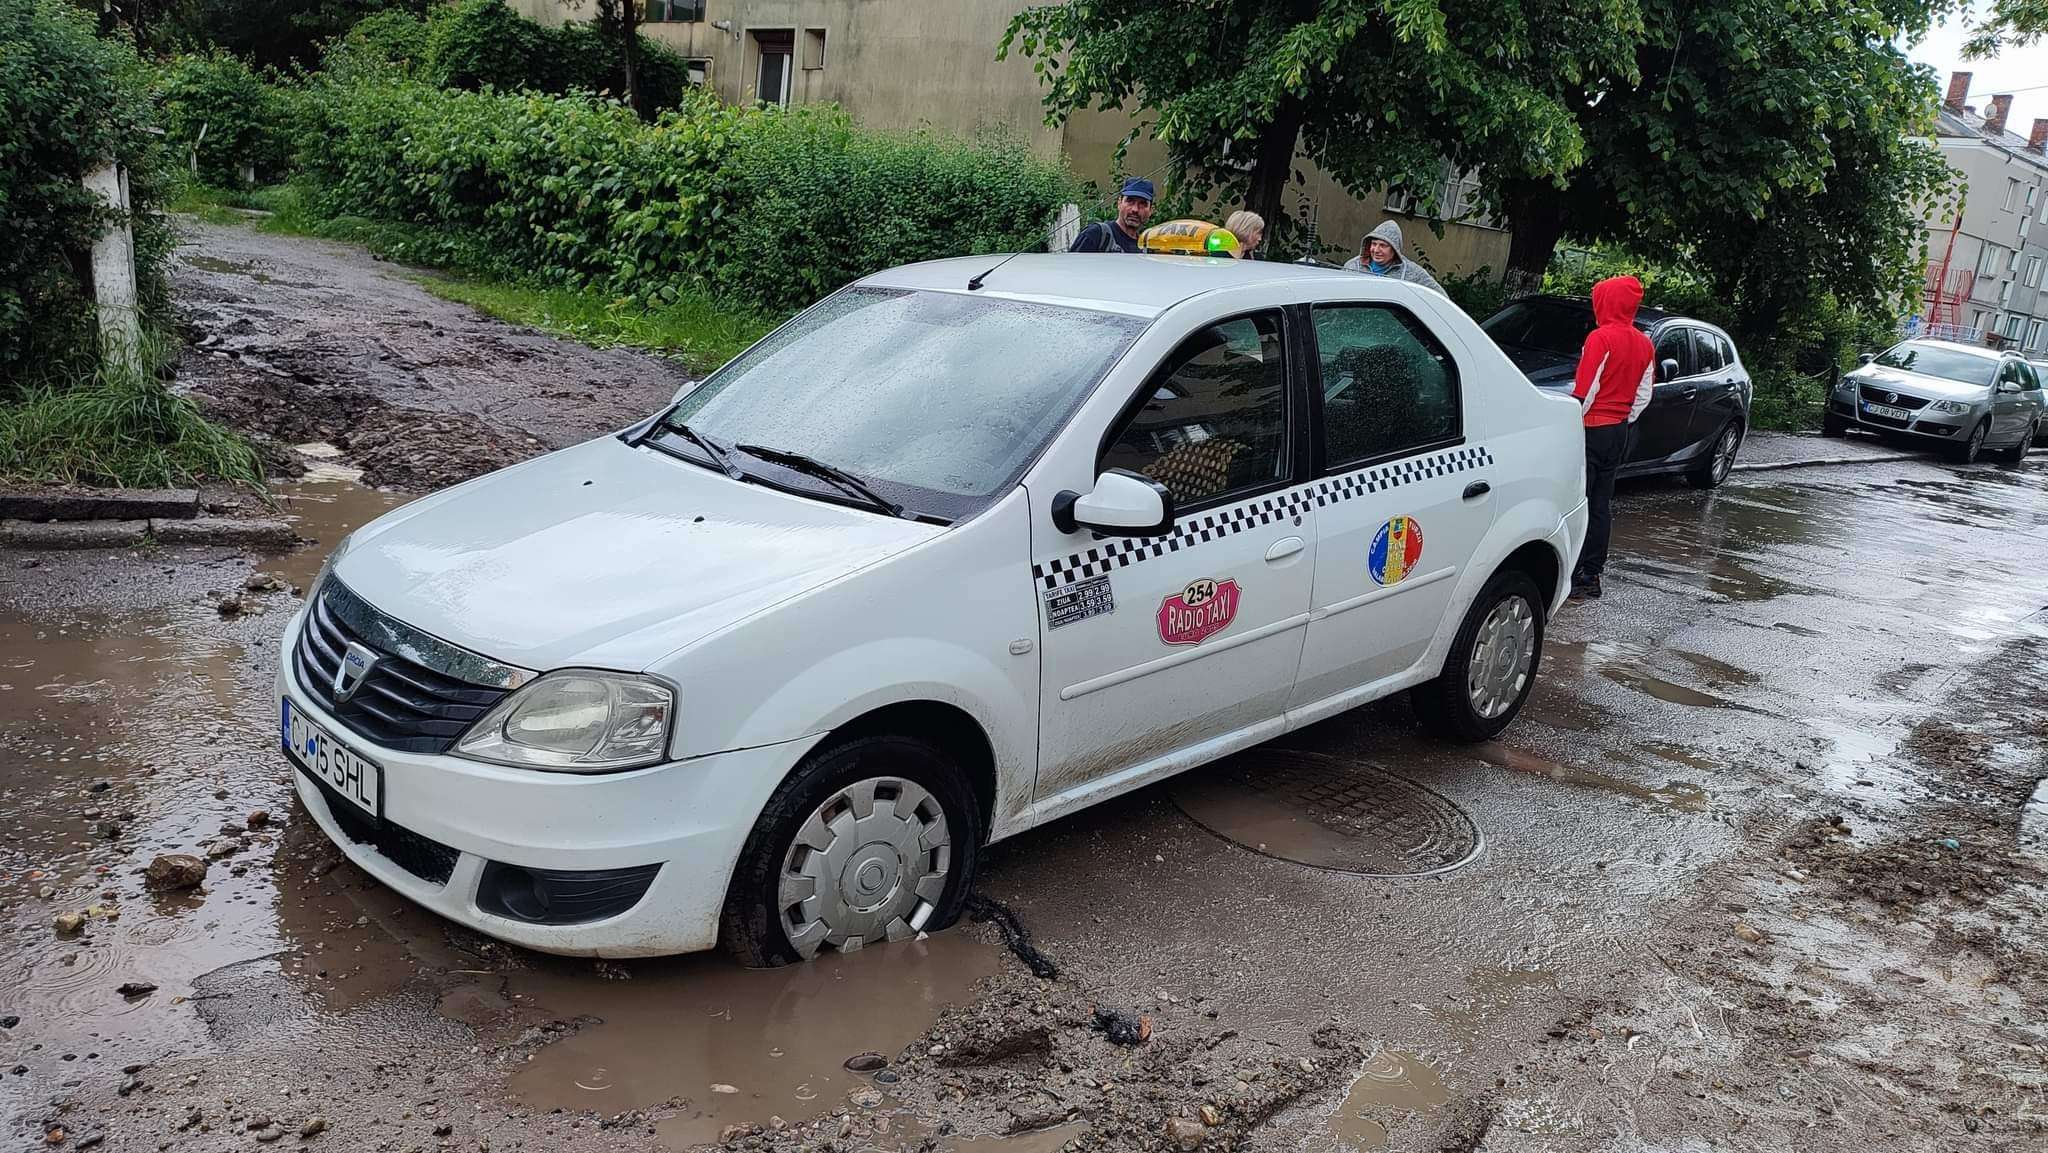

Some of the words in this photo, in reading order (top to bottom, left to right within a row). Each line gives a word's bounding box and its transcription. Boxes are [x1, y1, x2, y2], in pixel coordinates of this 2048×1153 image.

[1158, 223, 1199, 237] TAXI
[1880, 407, 1889, 415] 08
[1057, 596, 1071, 606] ZIUA
[1078, 589, 1093, 599] 2.99
[1095, 583, 1110, 594] 2.99
[1187, 582, 1213, 604] 254
[1052, 605, 1078, 618] NOAPTEA
[1080, 599, 1095, 610] 3.59
[1097, 594, 1112, 605] 3.59
[1168, 605, 1204, 636] RADIO
[1206, 589, 1230, 625] TAXI
[347, 652, 365, 668] DACIA
[292, 715, 309, 759] CJ
[315, 733, 328, 774] 15
[334, 748, 371, 807] SHL
